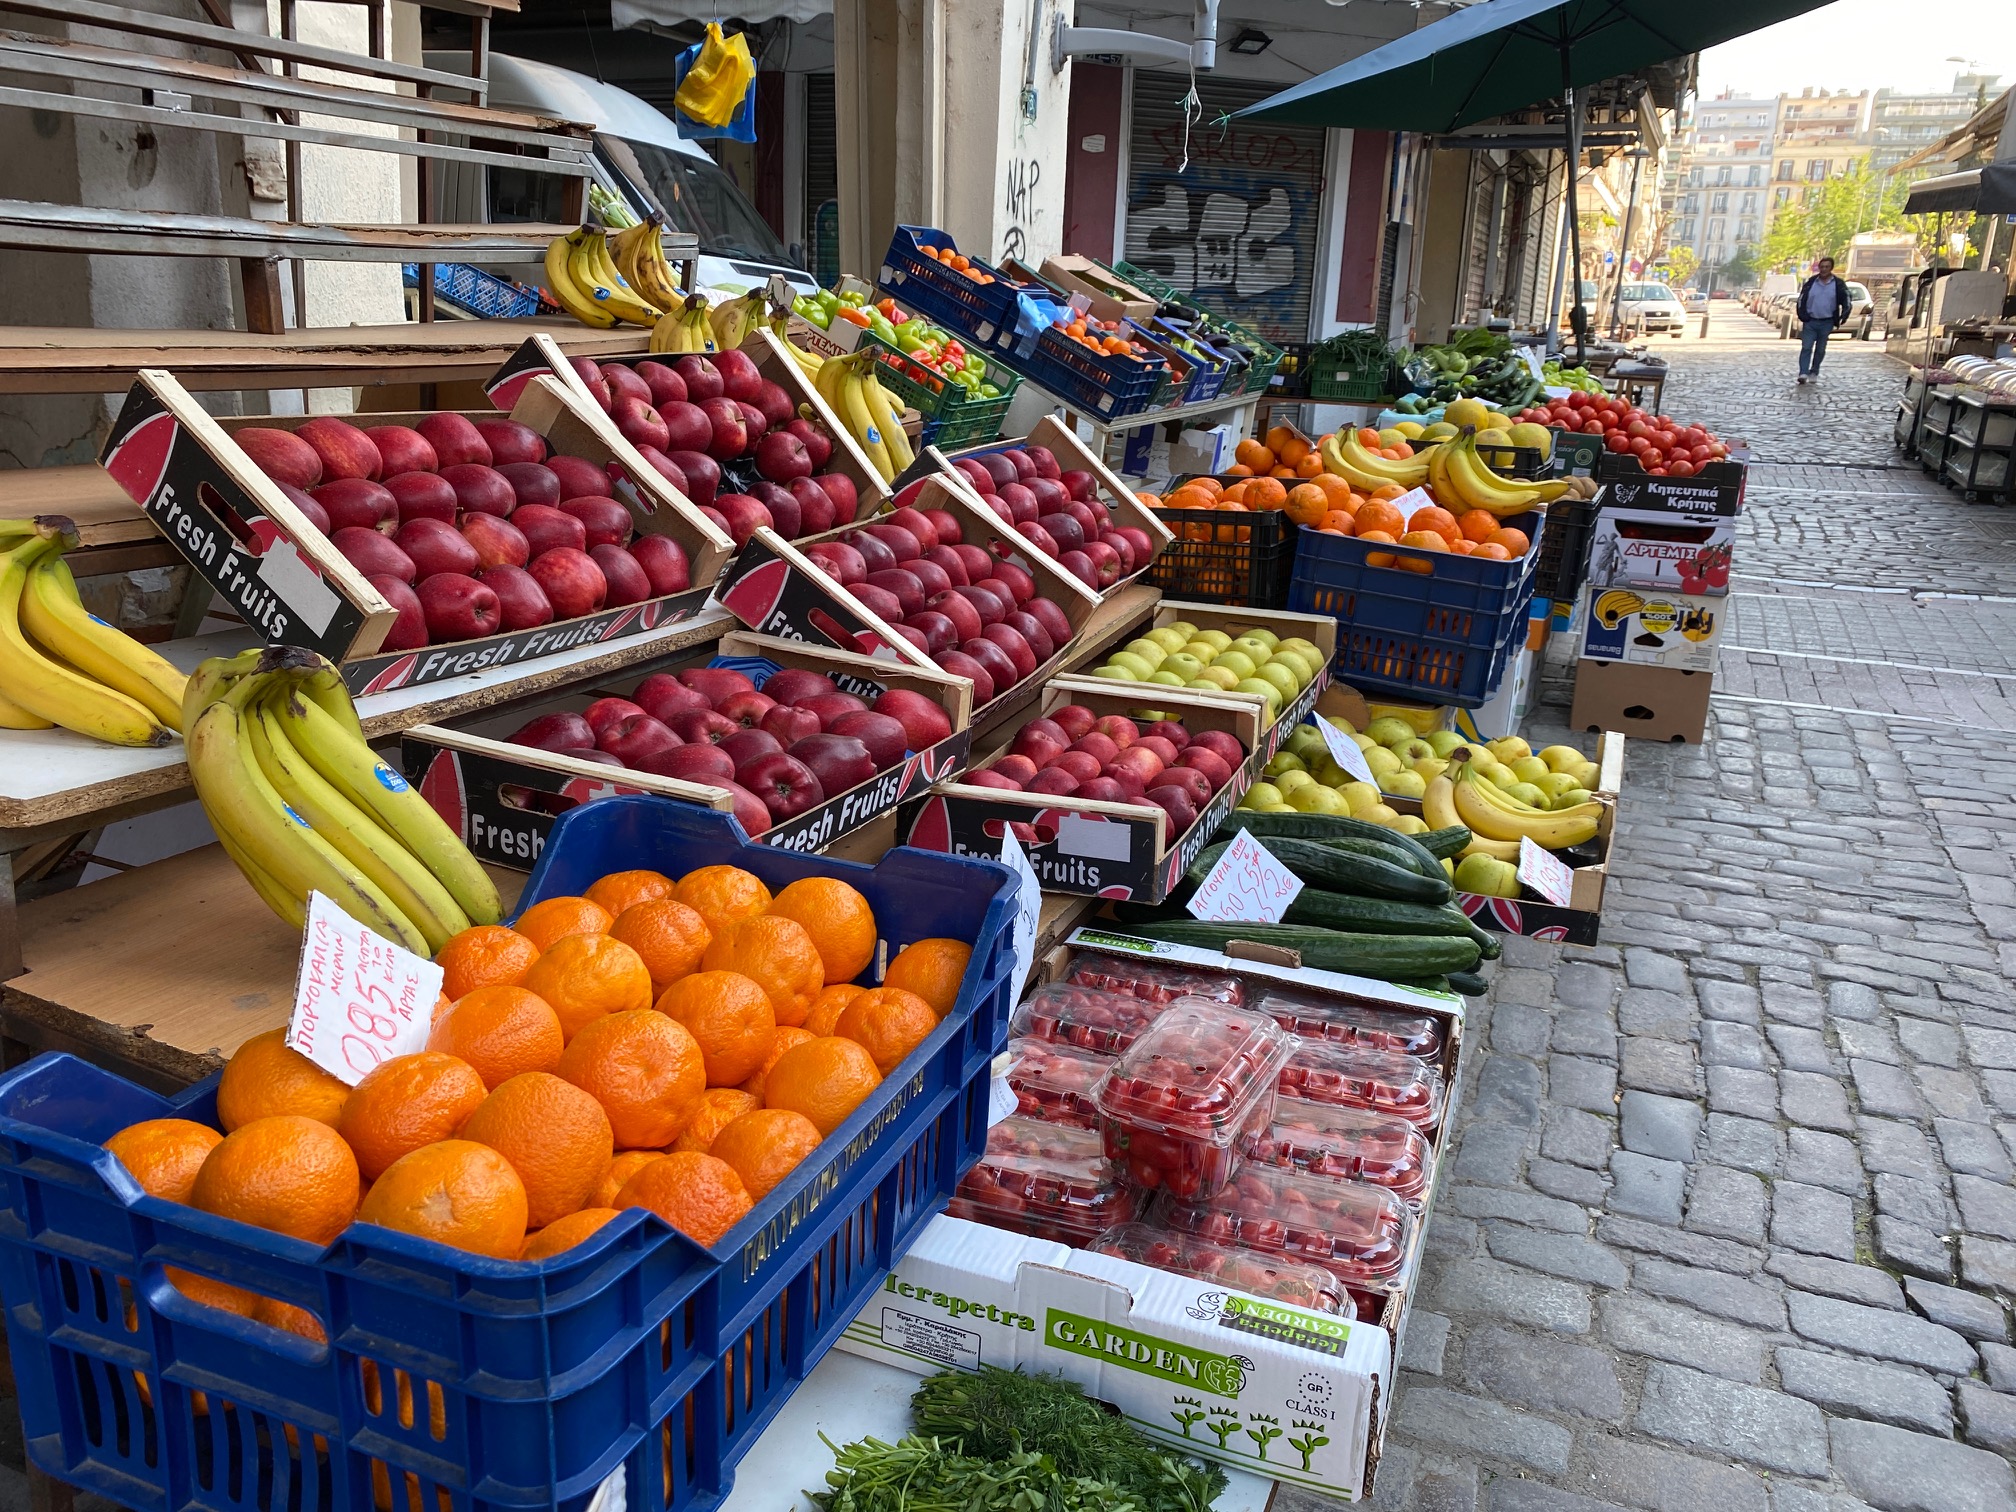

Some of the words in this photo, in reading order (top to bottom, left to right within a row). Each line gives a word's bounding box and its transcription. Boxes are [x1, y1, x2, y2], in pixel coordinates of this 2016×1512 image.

[1647, 482, 1719, 497] Κηπευτικά
[1667, 496, 1717, 511] Κρήτης
[155, 483, 217, 566] Fresh
[218, 552, 288, 638] Fruits
[1624, 542, 1697, 560] ΑΡΤΕΜΙΣ
[416, 639, 515, 681] Fresh
[519, 620, 608, 658] Fruits
[1587, 643, 1622, 655] Bananas
[1277, 715, 1296, 746] Fresh
[1296, 688, 1316, 724] Fruits
[838, 776, 899, 832] Fruits
[1180, 820, 1205, 875] Fresh
[1205, 791, 1231, 840] Fruits
[1029, 852, 1100, 887] Fruits
[1080, 935, 1141, 950] GARDEN
[884, 1273, 1036, 1332] Ierapetra
[1245, 1303, 1344, 1337] GARDEN
[1052, 1319, 1203, 1381] GARDEN
[1238, 1317, 1339, 1353] Ierapetra
[1307, 1382, 1324, 1394] GR
[1285, 1398, 1328, 1419] CLASS
